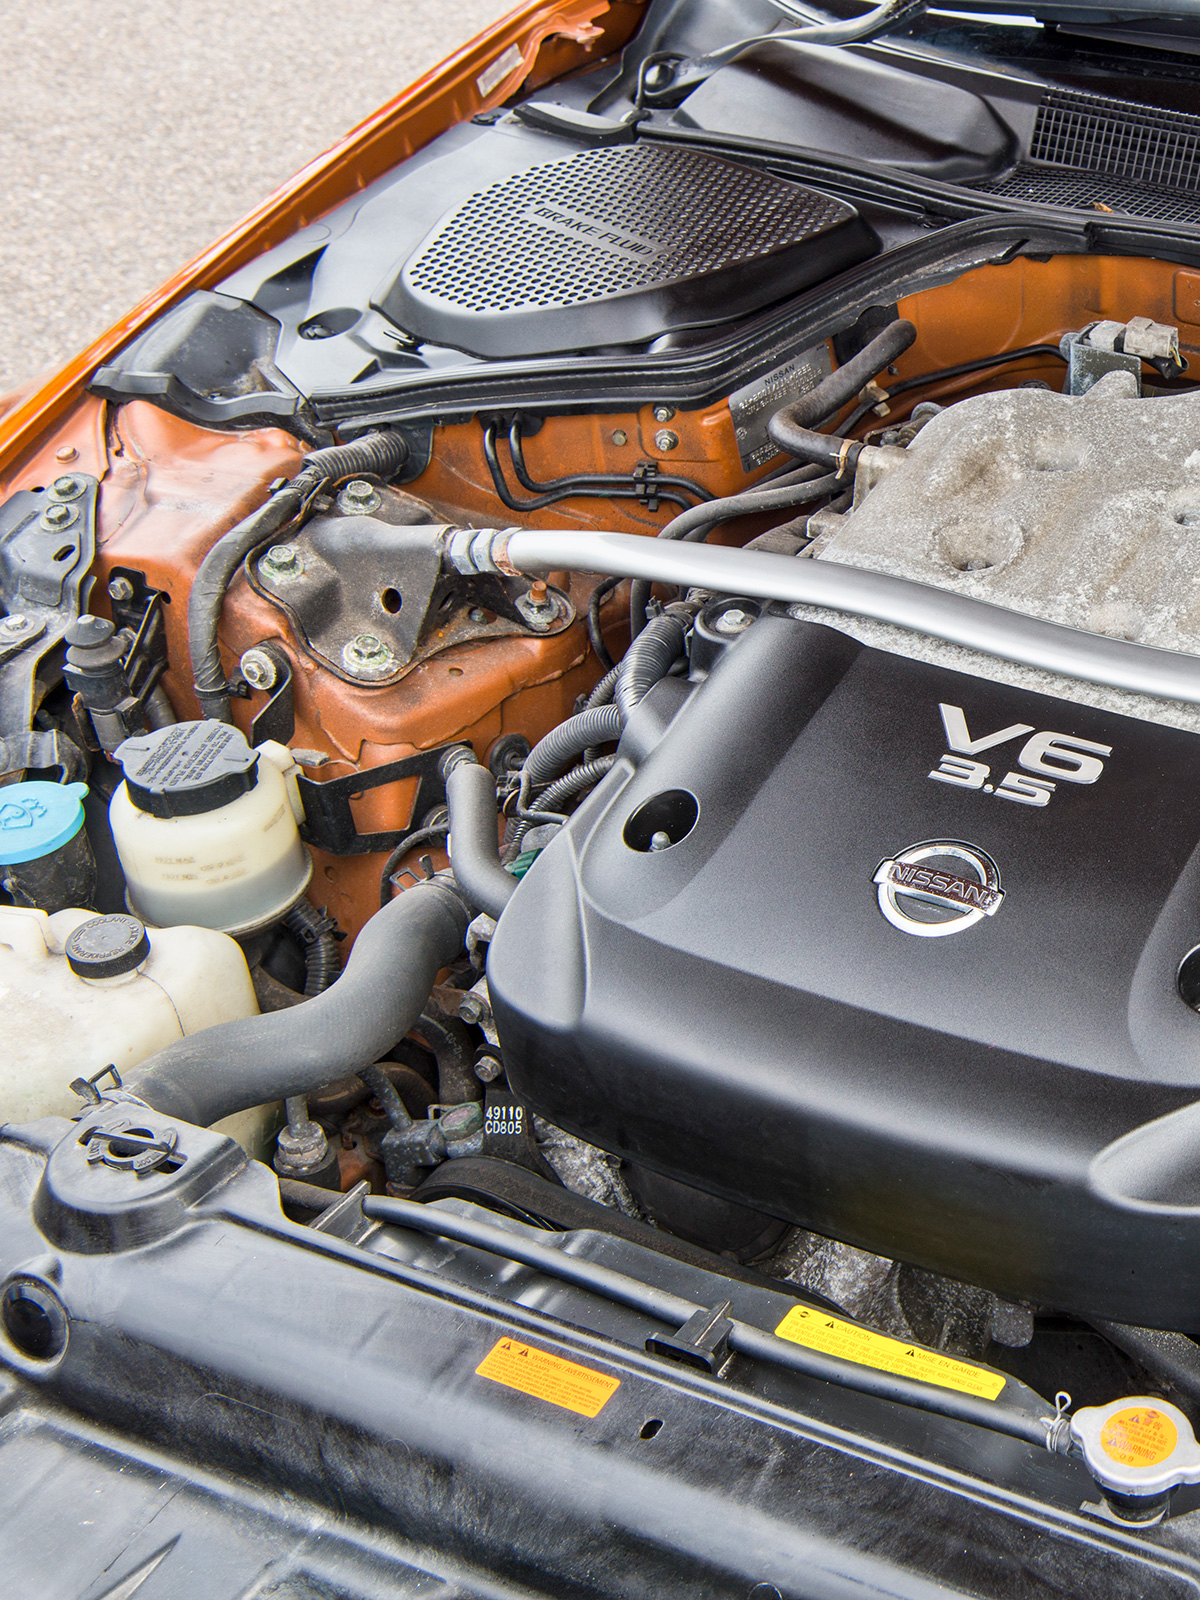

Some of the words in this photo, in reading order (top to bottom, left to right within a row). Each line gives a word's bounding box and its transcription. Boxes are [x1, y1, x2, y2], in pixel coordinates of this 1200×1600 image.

[533, 207, 602, 236] BRAKE
[598, 232, 656, 256] FLUID
[764, 363, 795, 387] NISSAN
[939, 702, 1113, 785] V6
[927, 754, 1056, 807] 3.5
[888, 864, 988, 904] NISSAN
[86, 916, 127, 929] COOLANT
[485, 1105, 523, 1120] 49110
[484, 1120, 522, 1135] CD805
[834, 1324, 873, 1341] CAUTION
[495, 1349, 517, 1360] XENON
[516, 1357, 551, 1373] HEADLAMPS
[531, 1354, 563, 1370] WARNING
[565, 1367, 615, 1389] AVERTISSEMENT
[916, 1352, 938, 1364] MISE
[938, 1359, 951, 1368] EN
[951, 1364, 981, 1379] GARDE
[1118, 1440, 1156, 1460] WARNING
